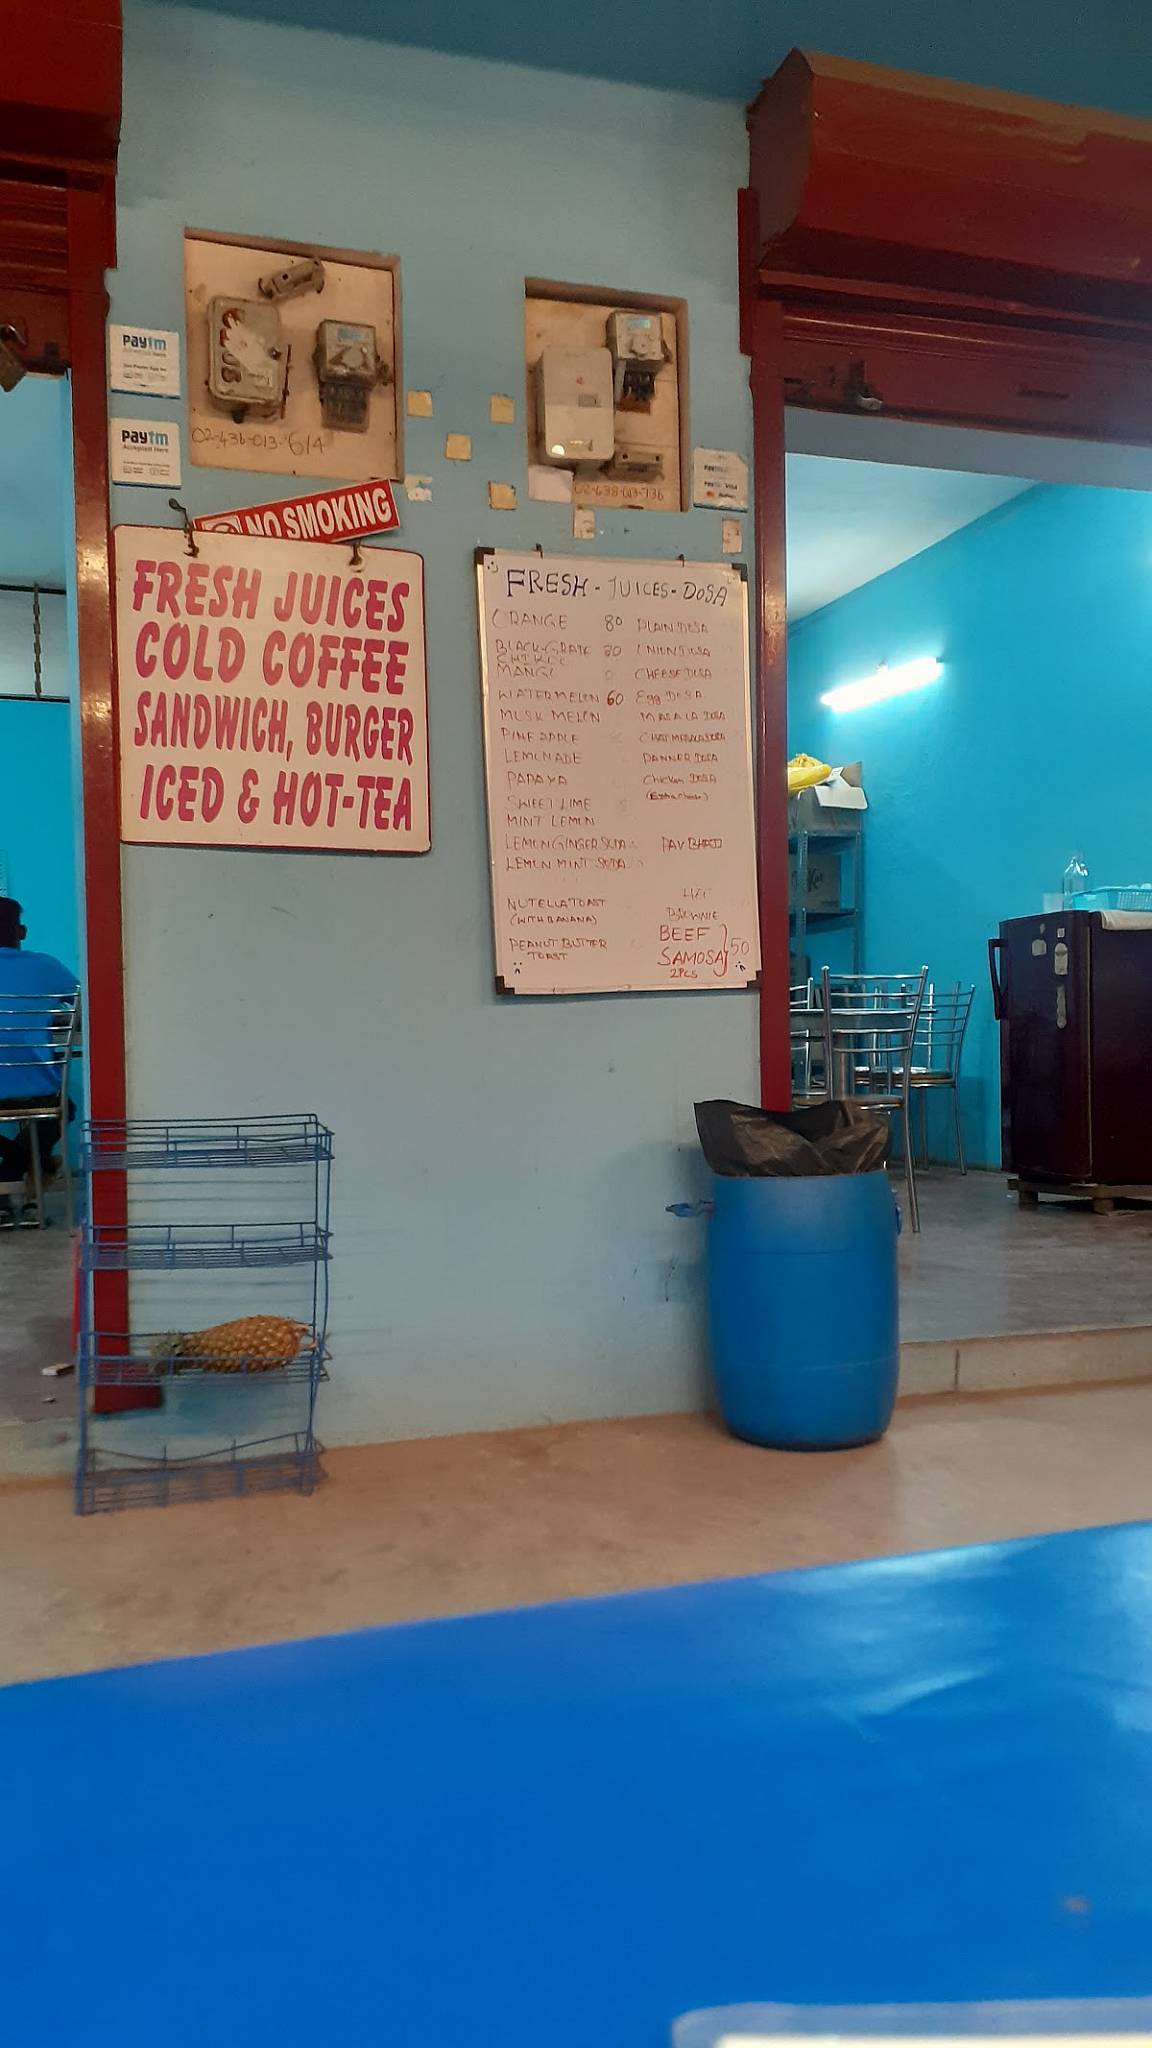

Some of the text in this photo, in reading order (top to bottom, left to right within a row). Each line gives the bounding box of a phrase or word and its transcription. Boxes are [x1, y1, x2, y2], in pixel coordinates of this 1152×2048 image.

[282, 487, 392, 540] SMOKING
[506, 569, 589, 597] FRESH
[607, 576, 668, 600] JUICES
[132, 559, 410, 633] FRESH JUICES
[604, 614, 623, 632] 80
[135, 621, 409, 695] COLD COFFEE
[607, 689, 625, 706] 60
[134, 690, 414, 766] SANDWICH, BURGER
[507, 770, 567, 791] PAPAYA
[139, 763, 412, 831] ICED & HOT-TEA
[507, 813, 544, 827] MINT
[660, 924, 710, 941] BEEF
[509, 937, 558, 952] PEANUT
[730, 937, 750, 956] 50
[657, 946, 724, 966] SAMOSA
